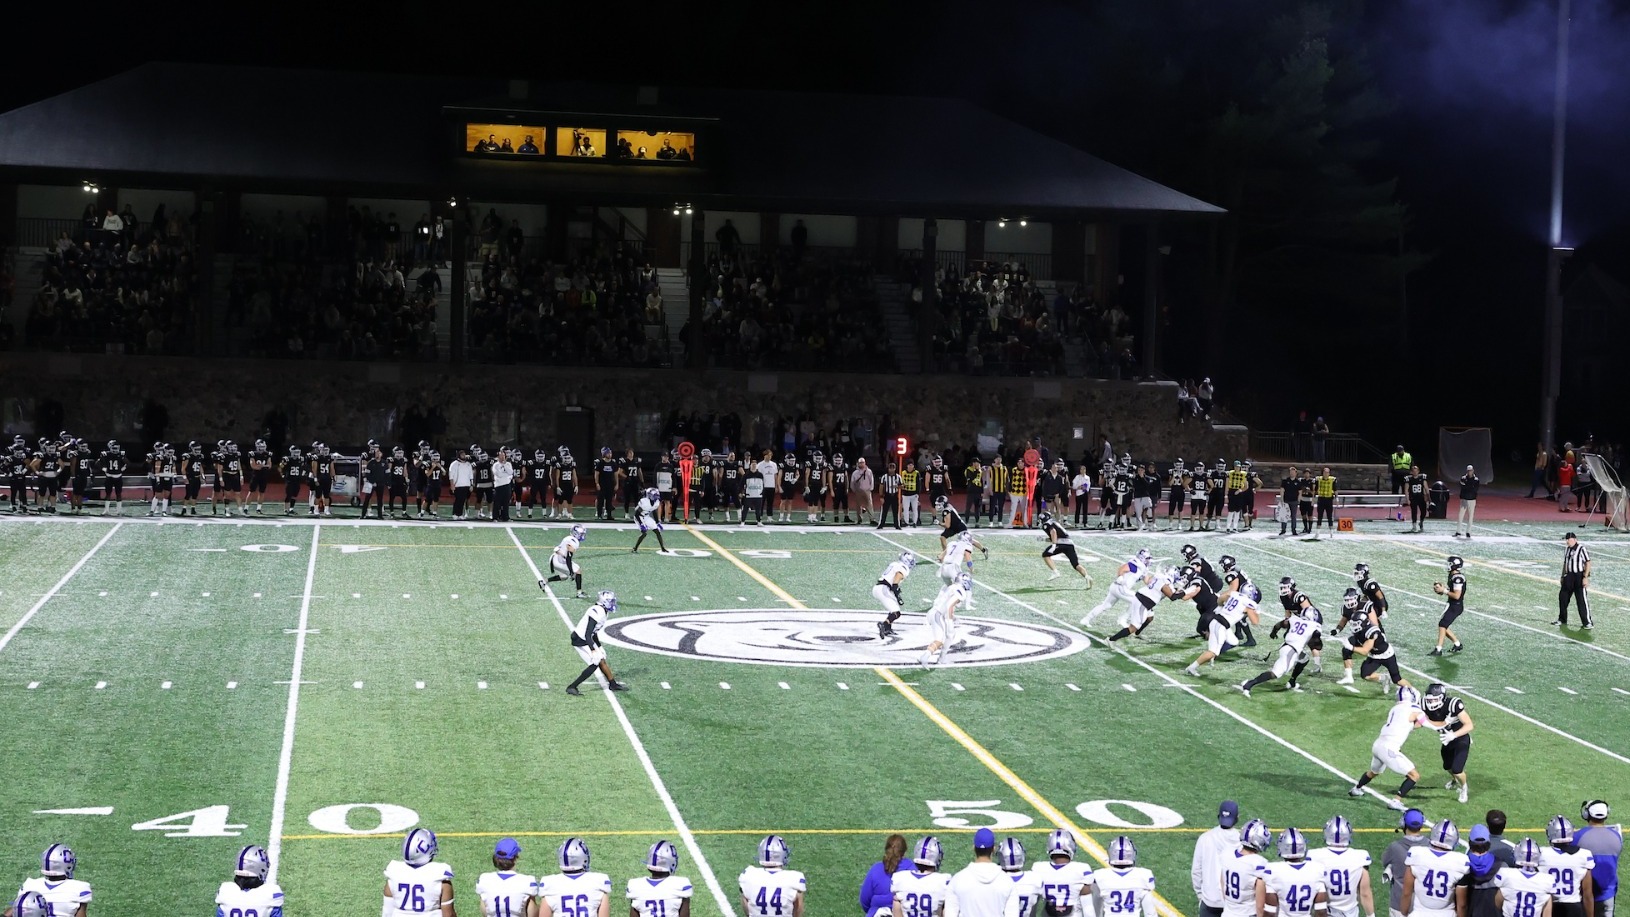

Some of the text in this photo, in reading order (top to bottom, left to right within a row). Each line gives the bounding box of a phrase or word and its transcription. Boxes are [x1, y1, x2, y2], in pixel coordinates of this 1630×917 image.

[897, 437, 907, 455] 3
[109, 460, 118, 470] 14
[229, 460, 238, 471] 49
[290, 466, 300, 475] 26
[320, 464, 329, 473] 54
[432, 470, 440, 480] 17
[480, 469, 488, 479] 18
[535, 469, 545, 479] 97
[562, 471, 571, 481] 28
[628, 466, 637, 477] 73
[726, 469, 737, 479] 50
[784, 472, 794, 482] 80
[812, 470, 821, 480] 95
[836, 473, 845, 483] 78
[933, 474, 943, 484] 56
[1213, 479, 1223, 488] 70
[1118, 481, 1126, 491] 12
[1195, 480, 1205, 490] 89
[1412, 484, 1422, 493] 68
[1341, 520, 1353, 529] 30
[949, 545, 957, 556] 7
[1290, 621, 1308, 636] 36
[1224, 869, 1240, 900] 19
[1329, 869, 1351, 896] 91
[1422, 869, 1449, 898] 43
[1548, 867, 1574, 895] 29
[398, 883, 426, 913] 76
[756, 886, 782, 915] 44
[1045, 884, 1070, 907] 57
[1285, 885, 1311, 912] 42
[494, 895, 511, 917] 11
[561, 894, 588, 917] 56
[906, 892, 932, 917] 39
[1110, 890, 1135, 913] 34
[1513, 891, 1537, 917] 18
